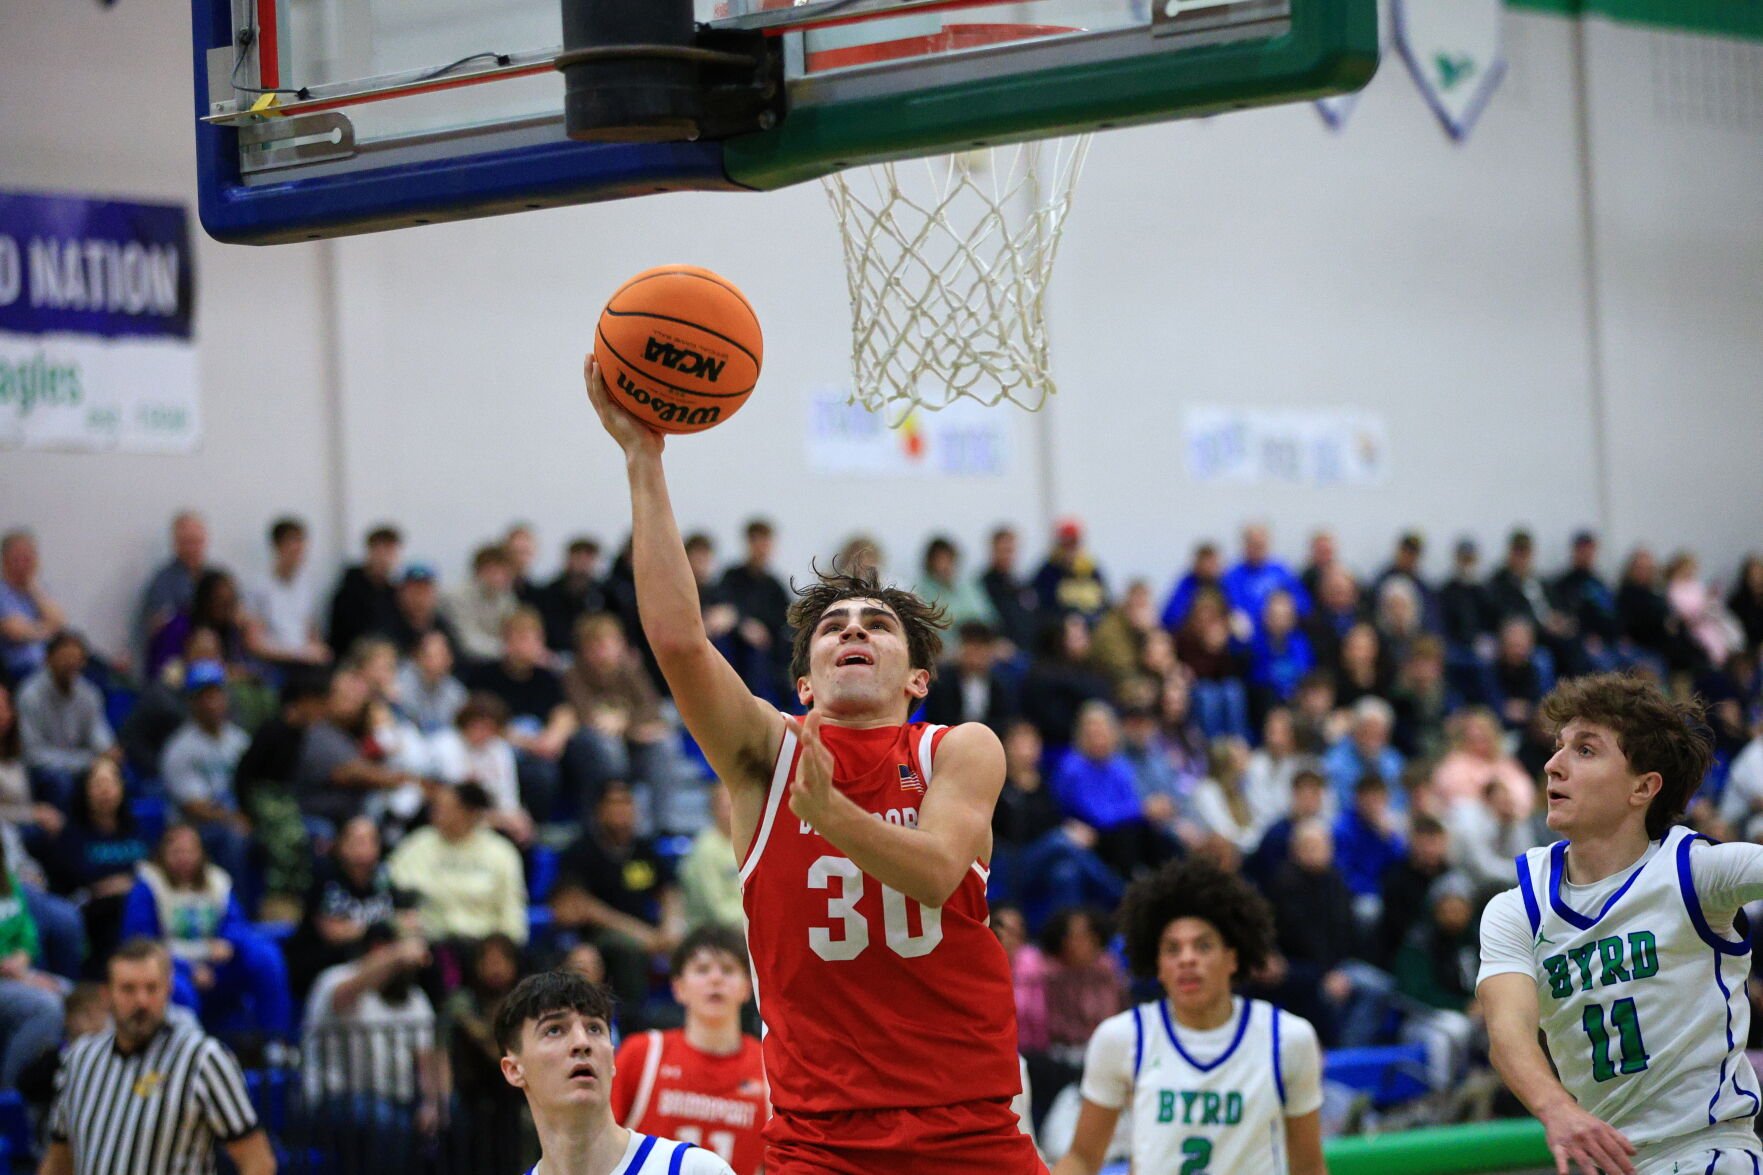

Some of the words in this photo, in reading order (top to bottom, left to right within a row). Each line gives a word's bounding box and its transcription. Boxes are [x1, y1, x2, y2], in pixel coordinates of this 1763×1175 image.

[29, 236, 178, 315] NATION
[645, 336, 726, 382] NCAA
[616, 370, 721, 424] Wilson
[807, 855, 943, 961] 30
[1543, 930, 1659, 999] BYRD
[1583, 997, 1650, 1083] 11
[1157, 1089, 1243, 1125] BYRD
[1181, 1136, 1213, 1175] 2
